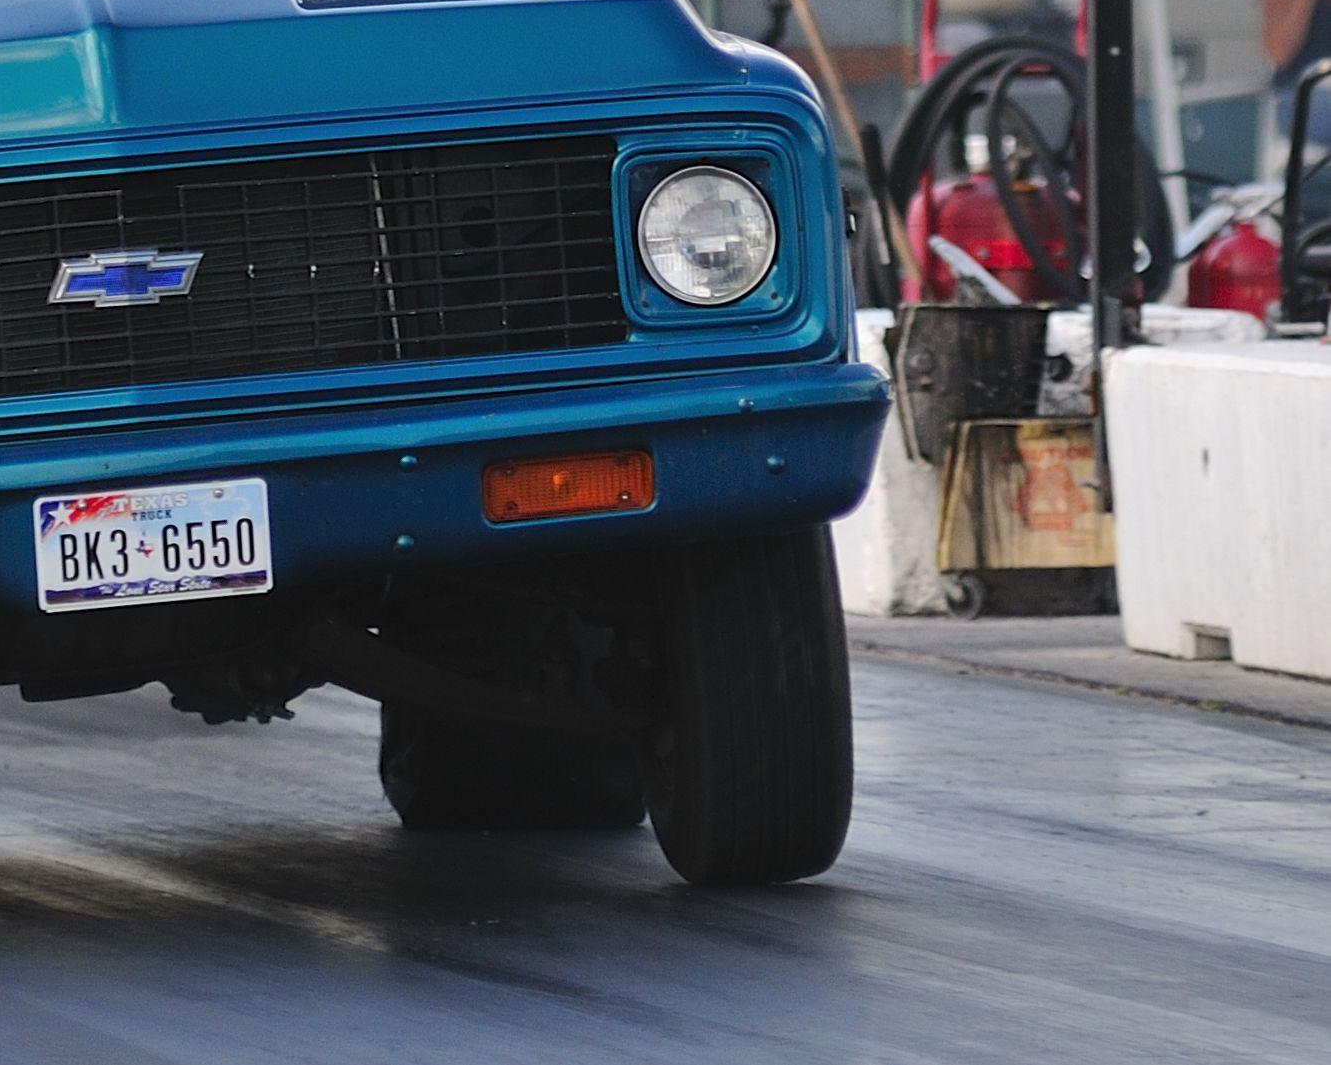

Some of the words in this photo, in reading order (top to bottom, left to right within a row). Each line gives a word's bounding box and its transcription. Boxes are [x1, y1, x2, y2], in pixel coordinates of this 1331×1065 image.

[112, 492, 189, 512] TEXAS
[131, 509, 172, 522] TRUCK
[60, 529, 129, 583] BK3
[162, 517, 256, 573] 6550
